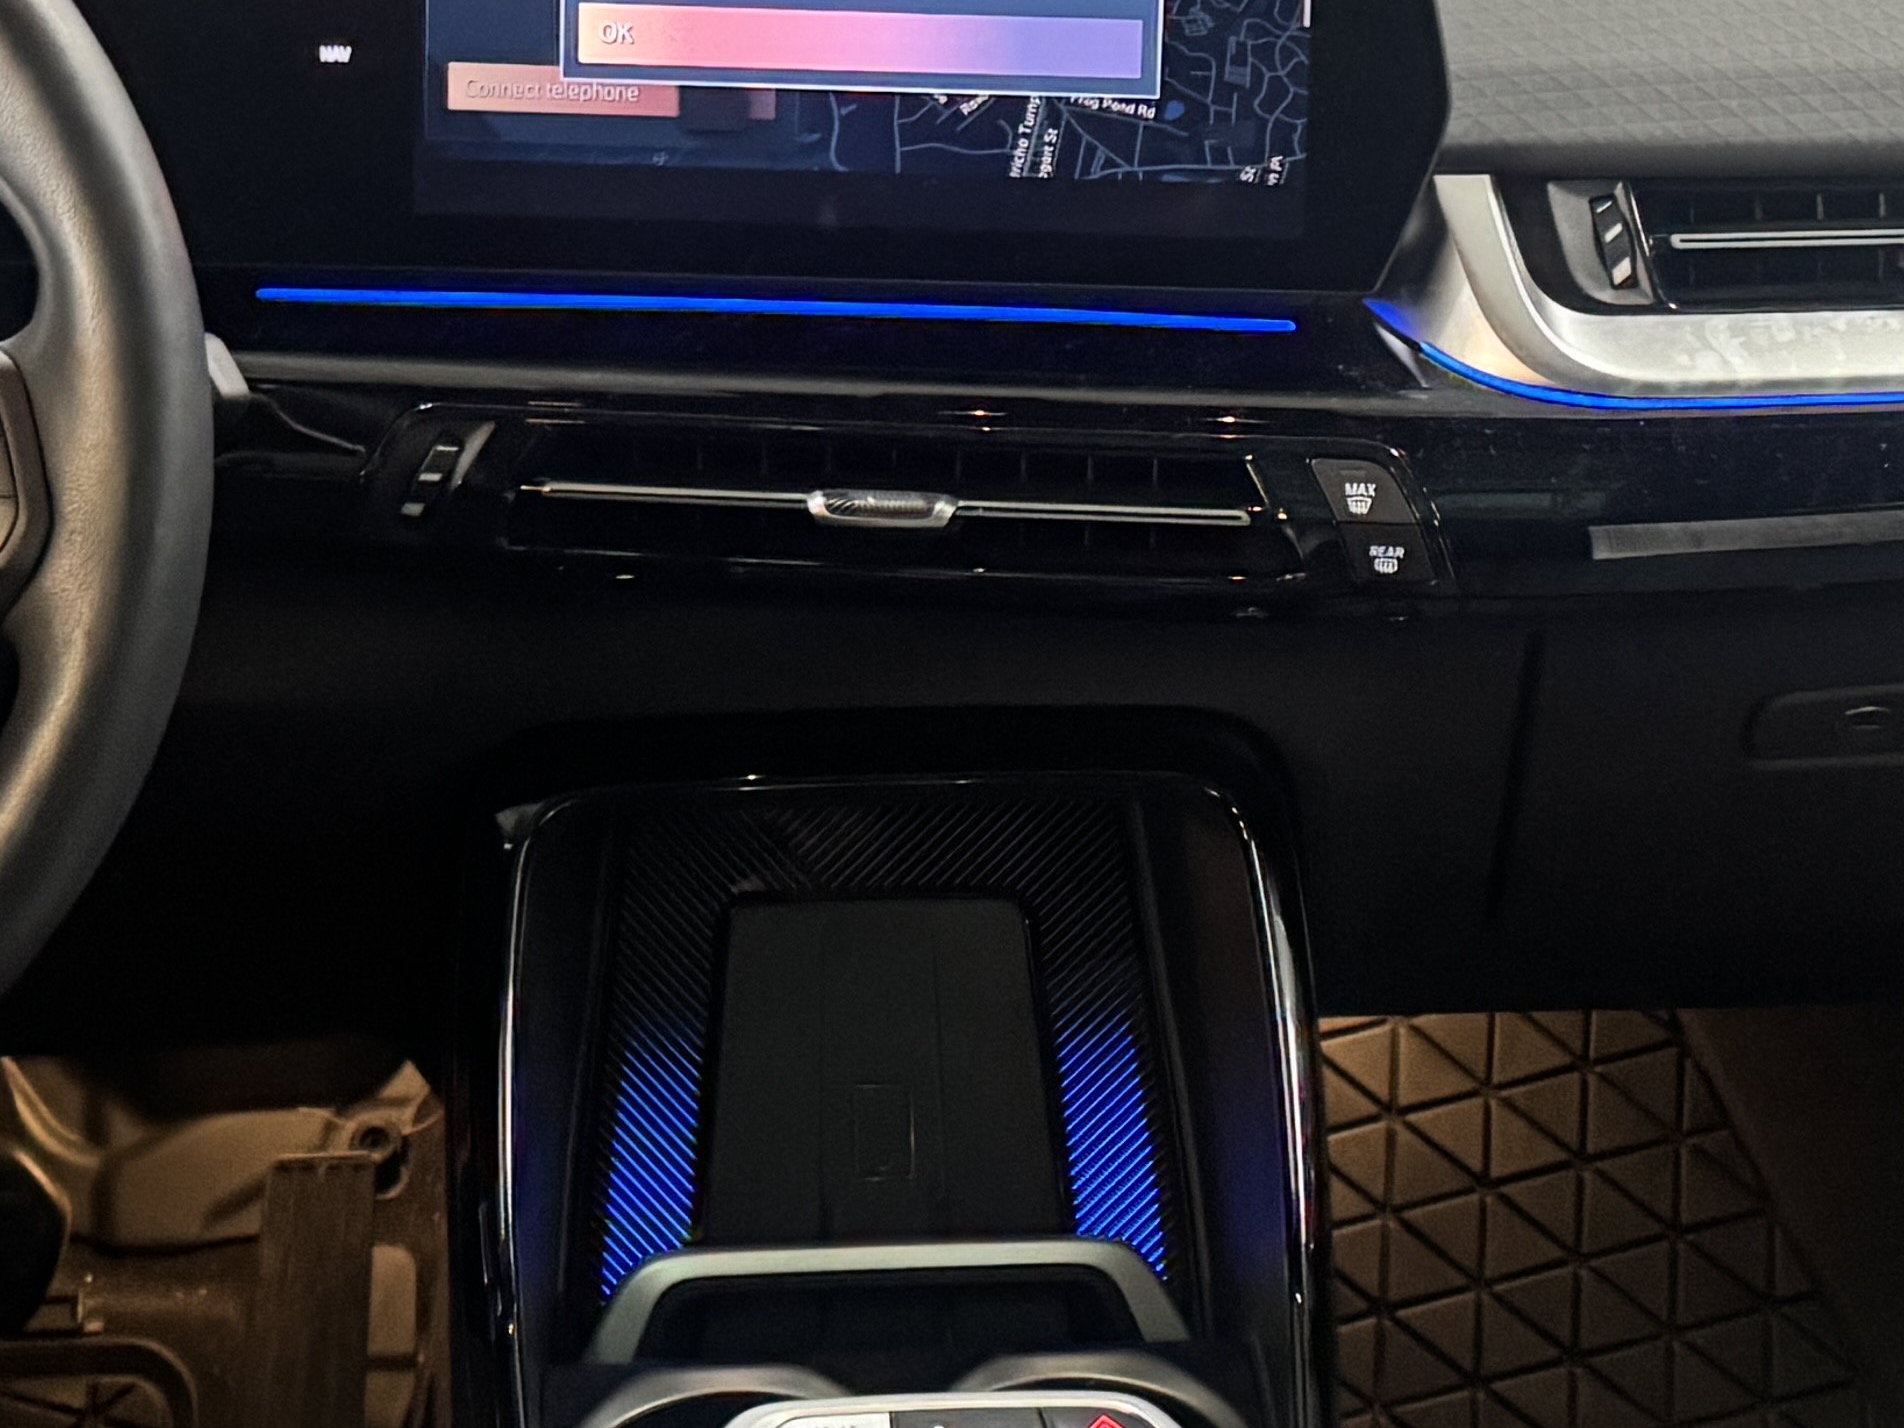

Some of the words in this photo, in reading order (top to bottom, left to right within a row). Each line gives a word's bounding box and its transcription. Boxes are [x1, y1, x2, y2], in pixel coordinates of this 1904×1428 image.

[599, 22, 635, 45] OK
[318, 44, 353, 64] NAV
[465, 78, 545, 100] Connect
[546, 81, 640, 103] telephone
[1345, 483, 1376, 497] MAX
[1369, 545, 1405, 559] REAR
